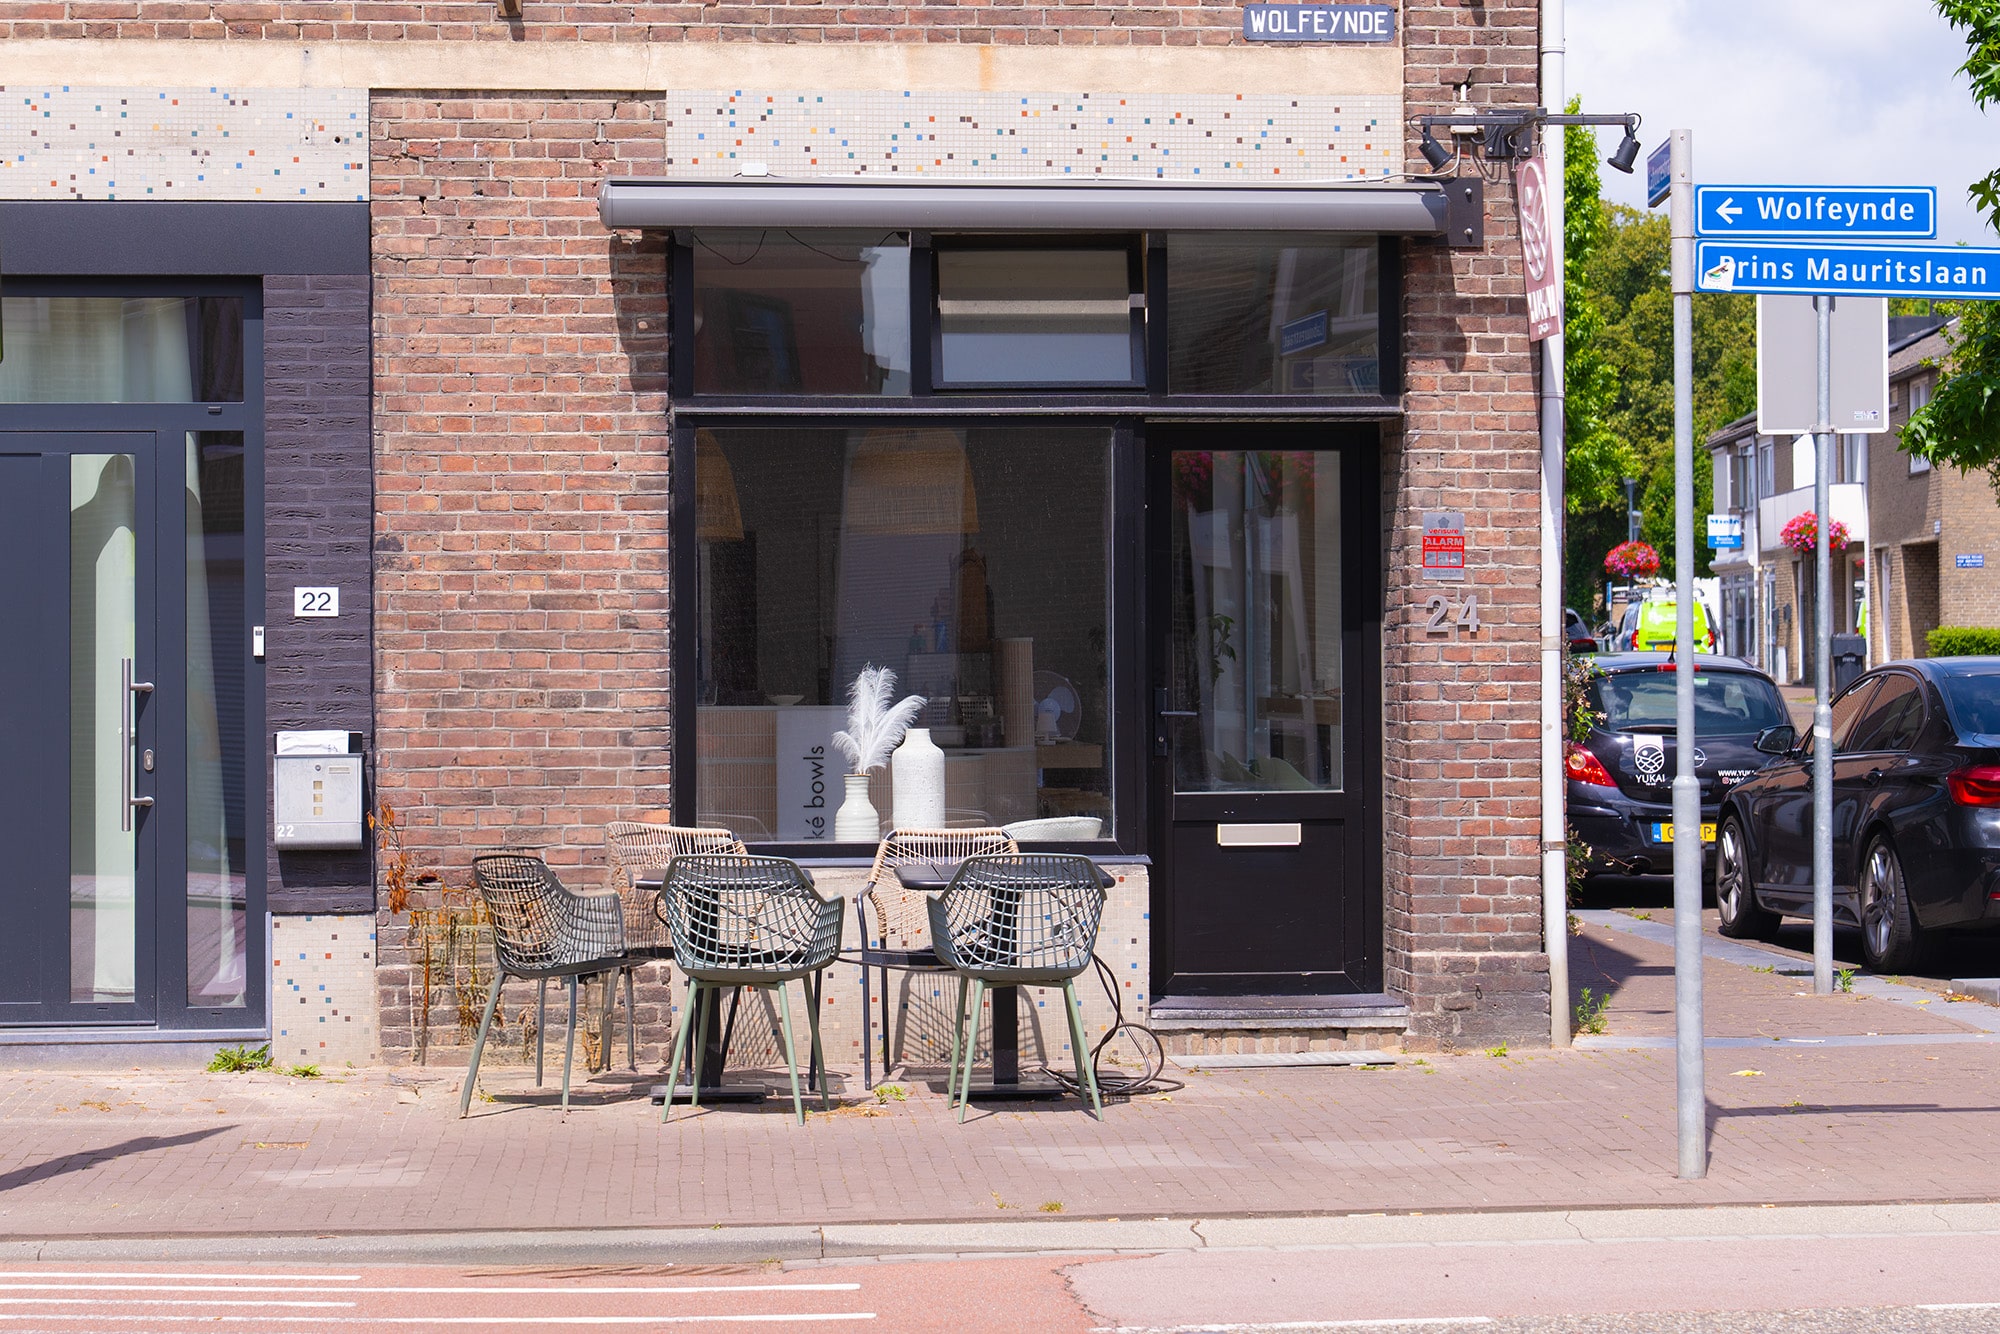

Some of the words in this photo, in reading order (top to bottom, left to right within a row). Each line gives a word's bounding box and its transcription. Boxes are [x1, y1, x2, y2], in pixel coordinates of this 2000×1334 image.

[1250, 10, 1388, 35] WOLFEYNDE
[1757, 196, 1914, 226] Wolfeynde
[1807, 257, 1987, 285] Mauritslaan
[1425, 537, 1463, 546] ALARM
[302, 592, 332, 612] 22
[1426, 594, 1480, 633] 24
[803, 745, 825, 808] bowls
[1635, 774, 1666, 783] YUKAI
[277, 825, 294, 837] 22
